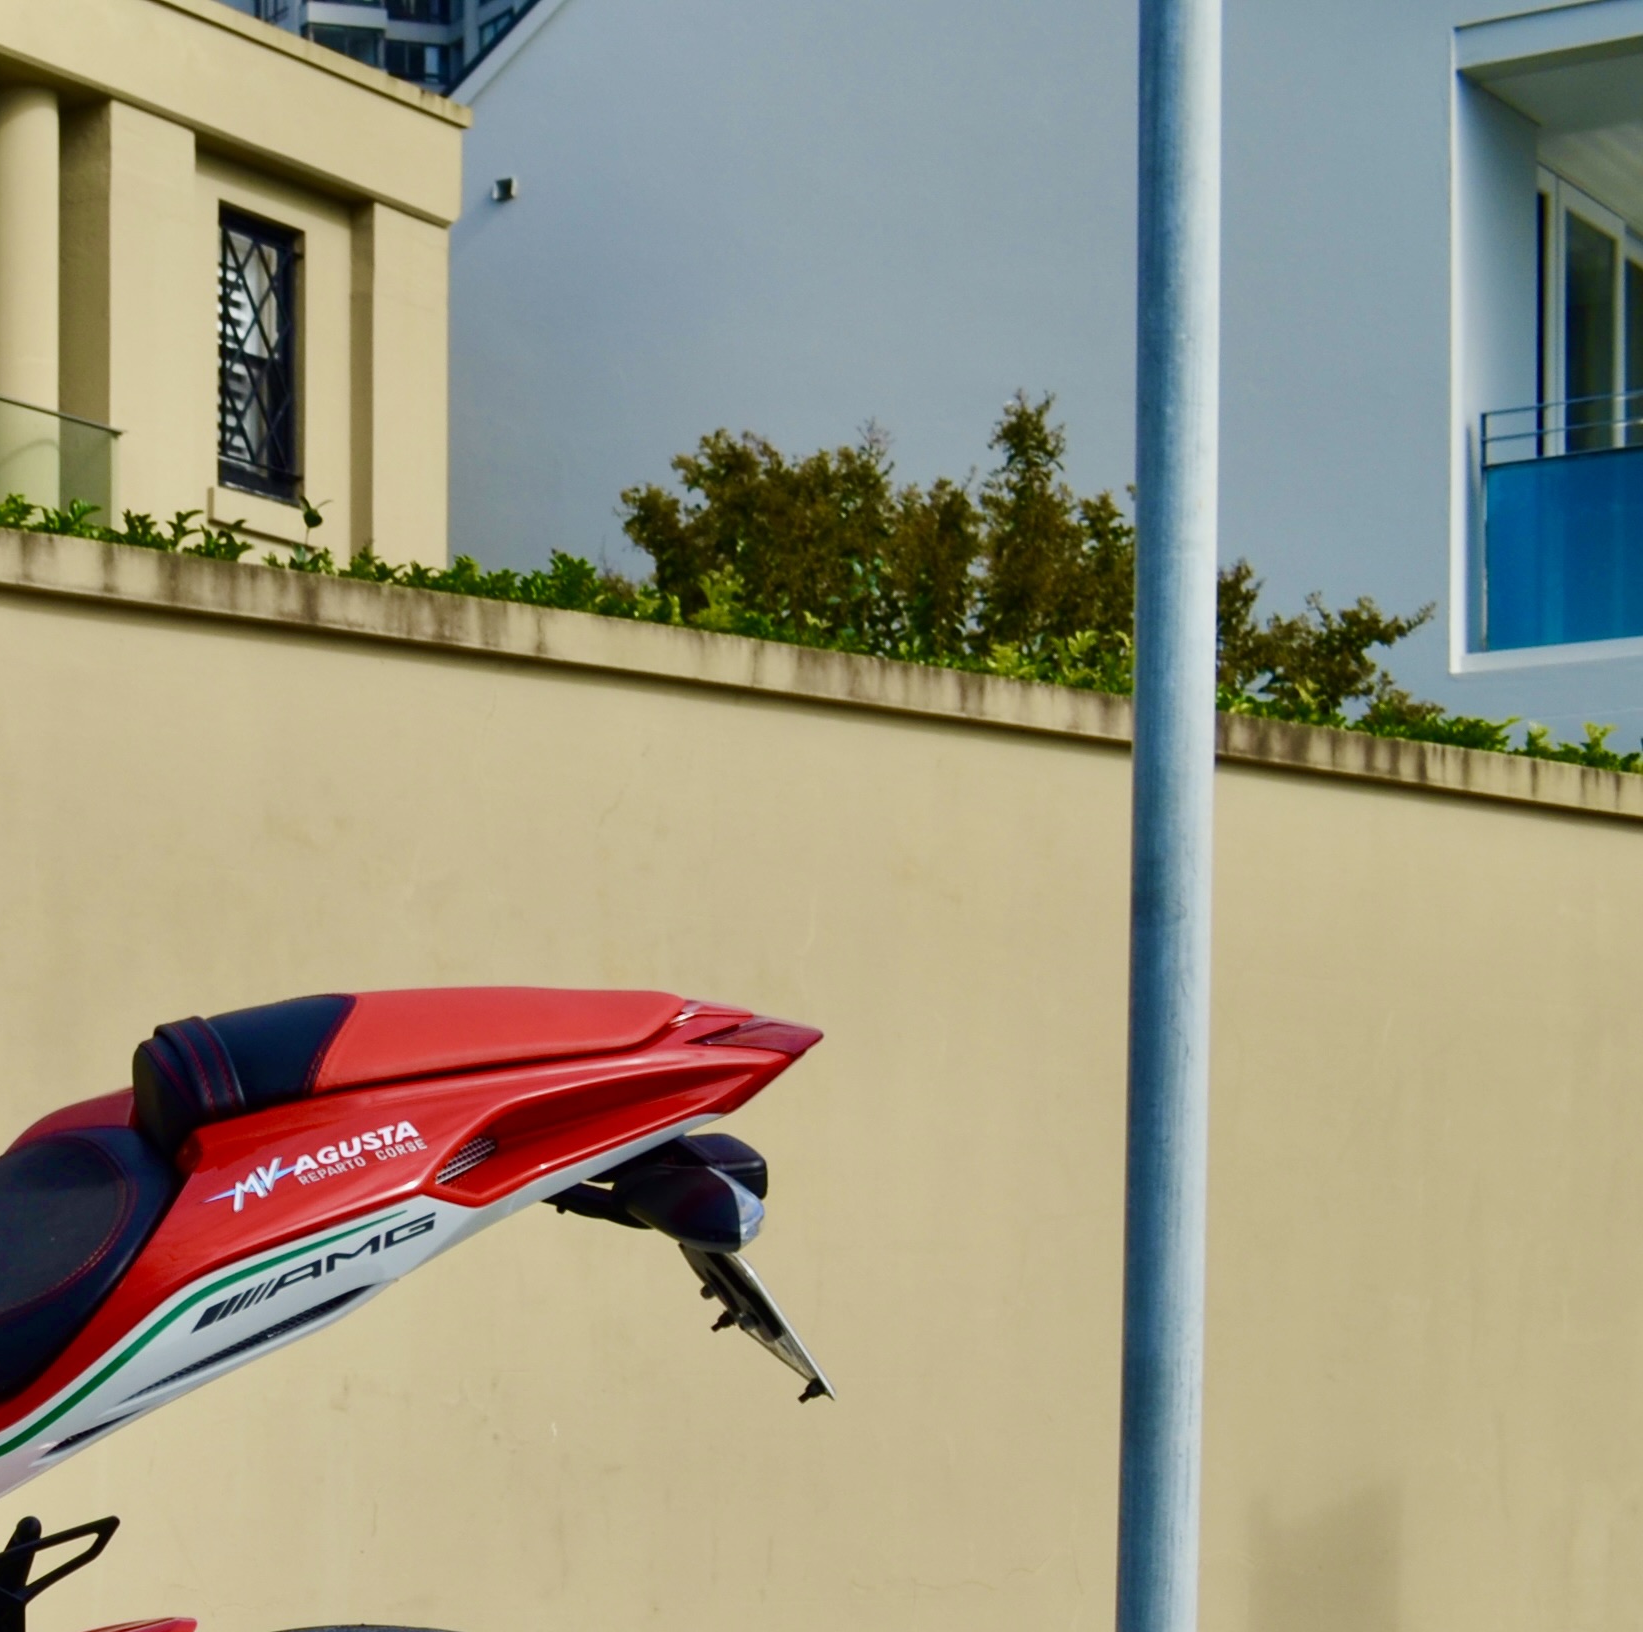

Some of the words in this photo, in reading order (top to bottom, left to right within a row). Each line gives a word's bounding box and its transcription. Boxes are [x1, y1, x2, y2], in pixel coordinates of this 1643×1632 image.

[233, 1157, 282, 1213] MV
[293, 1120, 420, 1176] AGUSTA
[298, 1156, 367, 1186] REPARTO
[375, 1138, 428, 1161] CORSE
